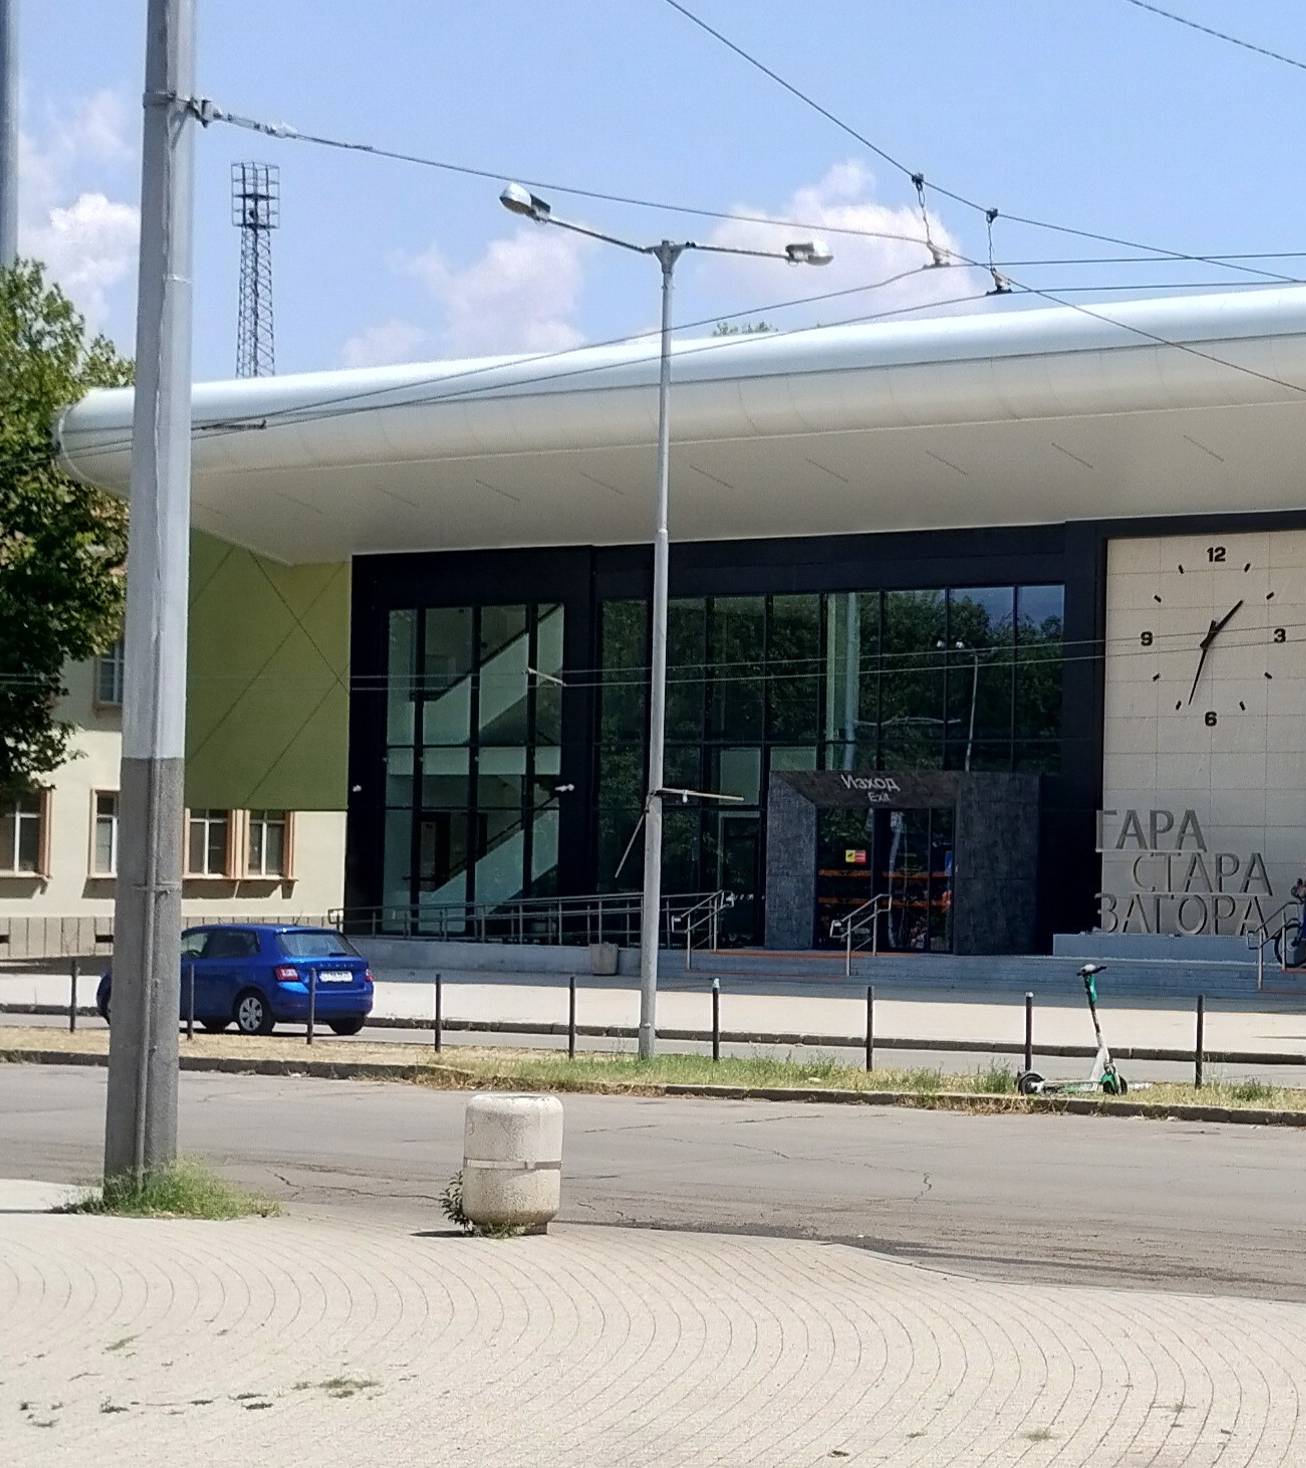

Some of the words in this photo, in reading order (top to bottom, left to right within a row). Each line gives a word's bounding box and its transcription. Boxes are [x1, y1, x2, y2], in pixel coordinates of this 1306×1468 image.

[1207, 546, 1226, 562] 12
[1140, 631, 1153, 646] 9
[1273, 628, 1286, 643] 3
[1205, 711, 1217, 726] 6
[841, 774, 900, 792] Изход
[868, 792, 890, 802] Exit
[1096, 809, 1207, 852] ГАРА
[1133, 852, 1273, 896] СТАРА
[1094, 893, 1269, 936] ЗАГОРА
